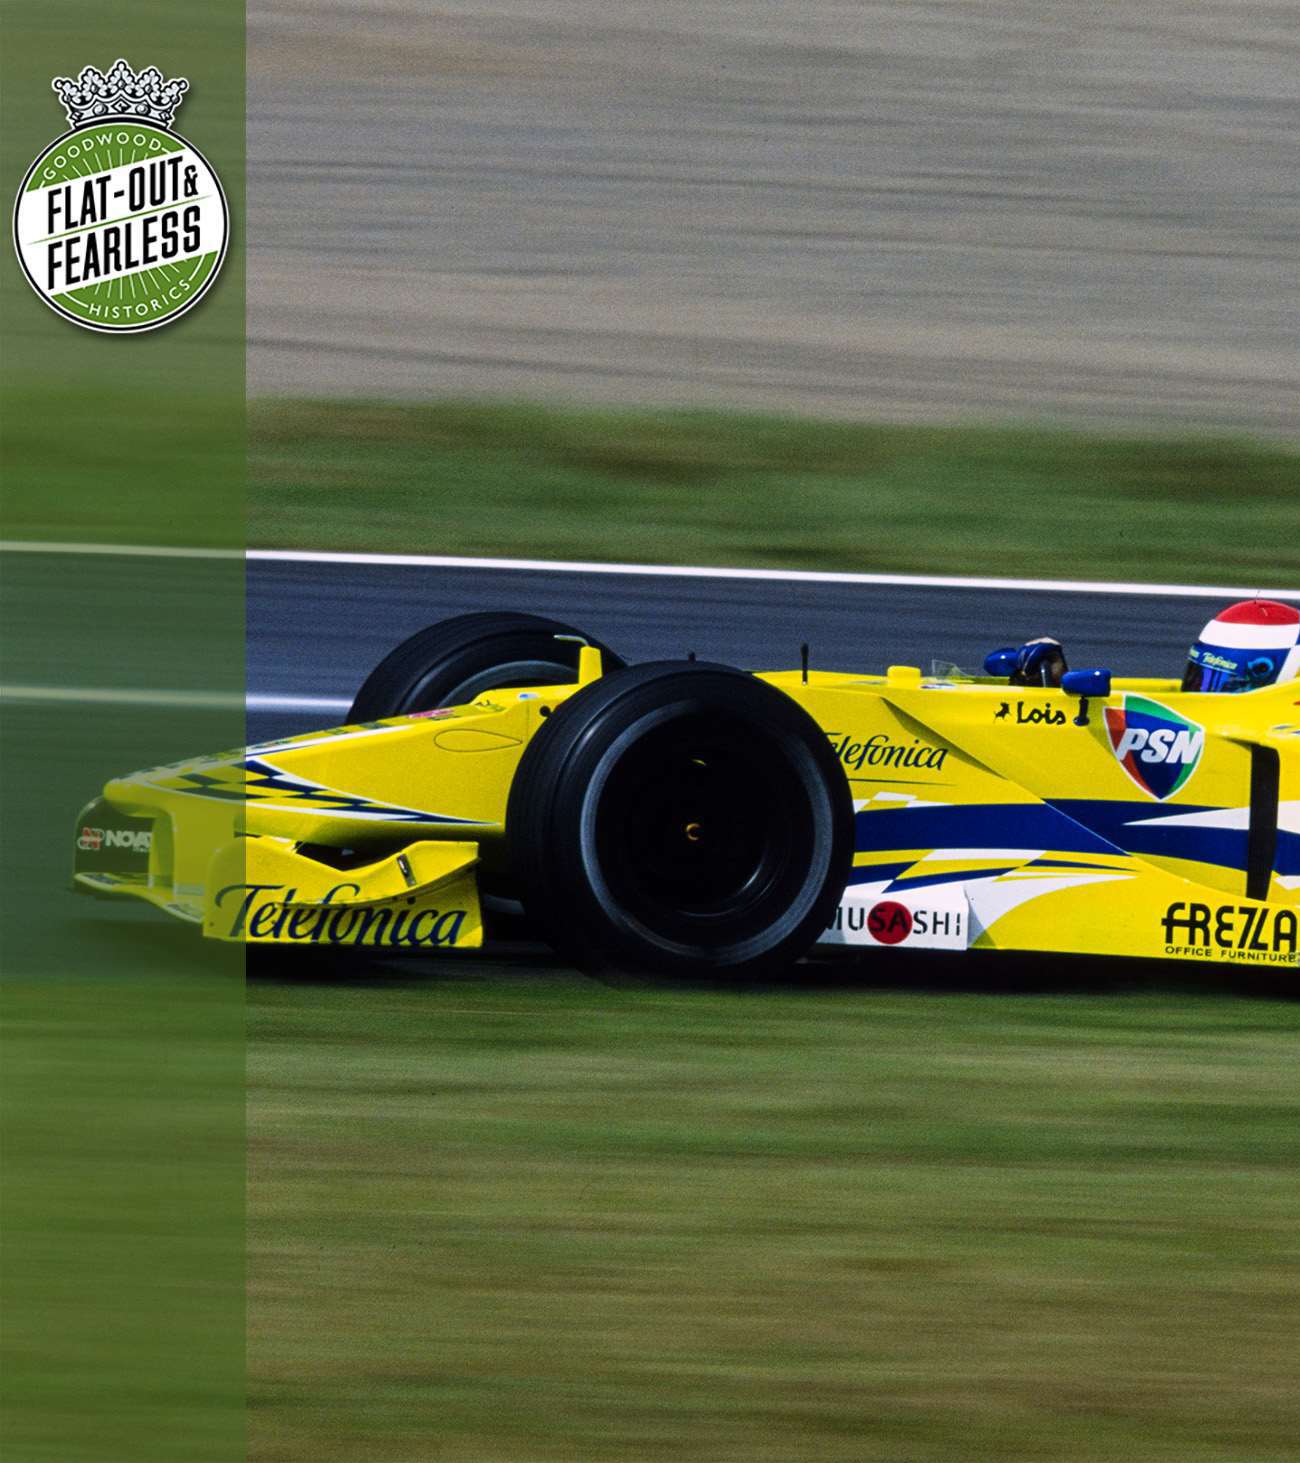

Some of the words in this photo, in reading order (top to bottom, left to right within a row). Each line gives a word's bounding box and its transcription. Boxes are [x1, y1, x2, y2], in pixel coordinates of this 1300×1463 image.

[1017, 701, 1066, 725] Lois
[1116, 728, 1203, 764] PSN
[1165, 945, 1213, 957] OFFICE
[1220, 949, 1300, 963] FURNITURE
